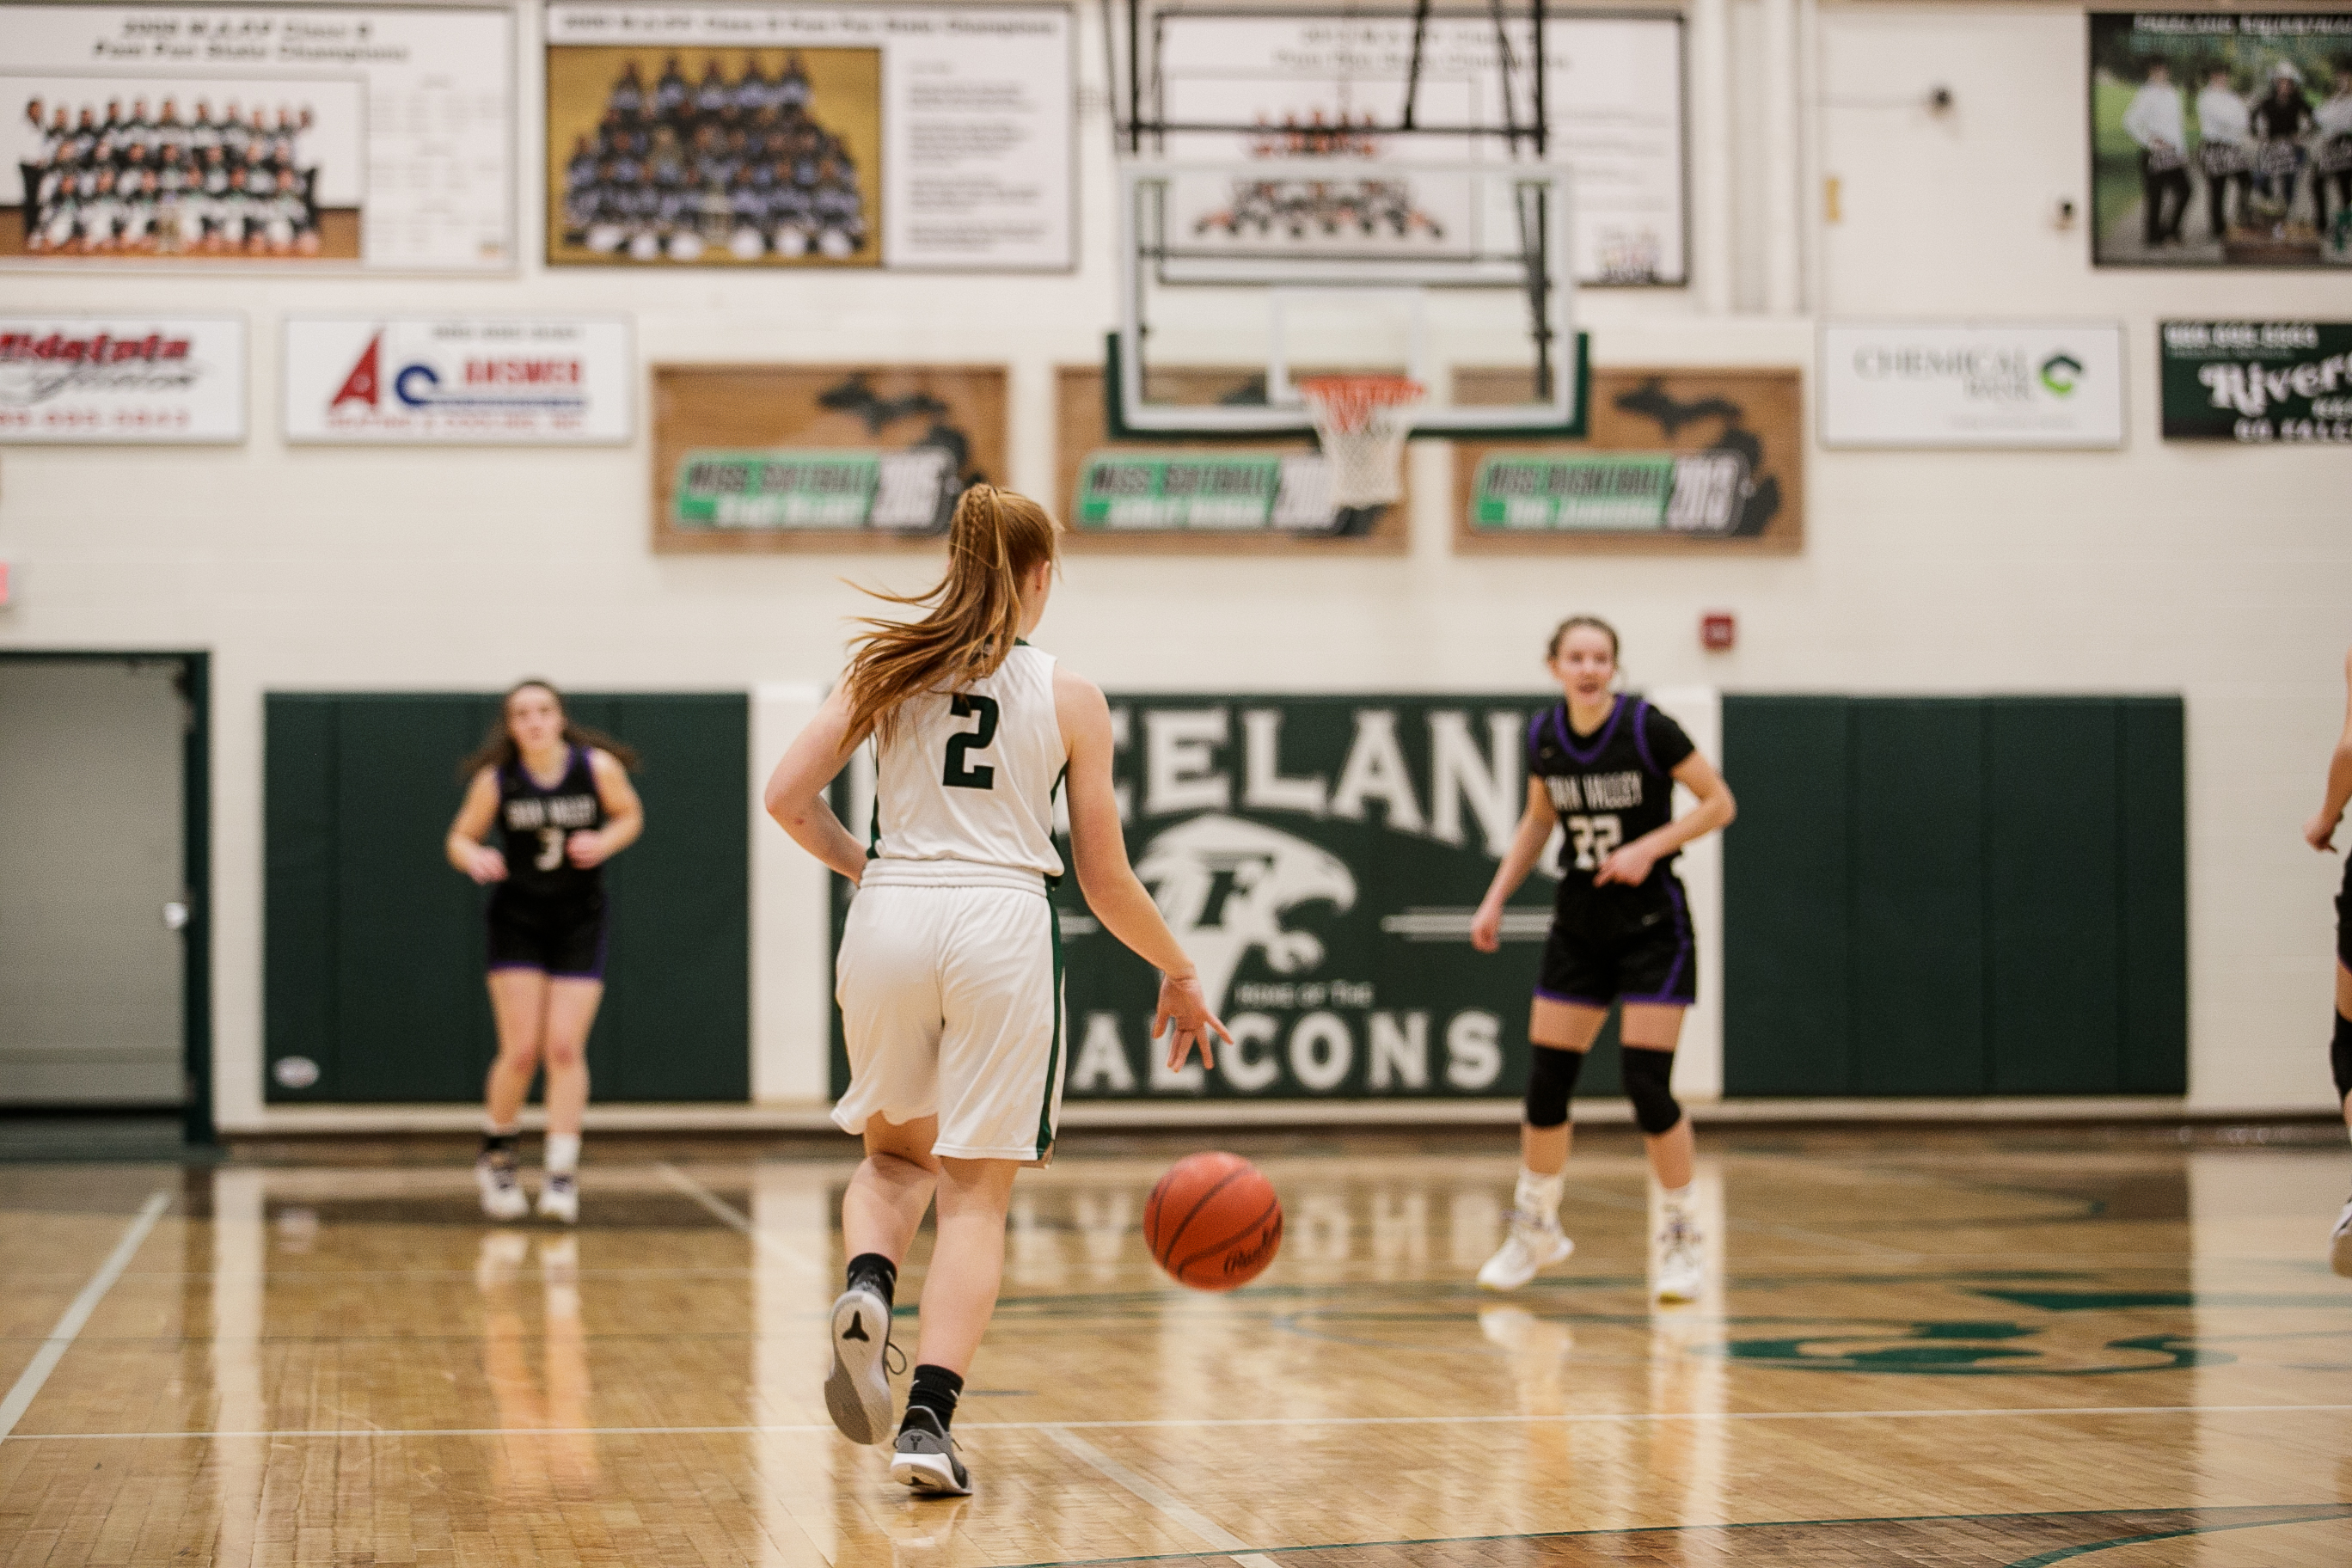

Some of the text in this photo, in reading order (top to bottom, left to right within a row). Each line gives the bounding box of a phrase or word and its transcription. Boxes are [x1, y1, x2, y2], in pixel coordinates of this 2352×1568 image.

[942, 693, 999, 790] 2
[532, 825, 566, 873] 3
[1071, 1009, 1504, 1092] ALCONS
